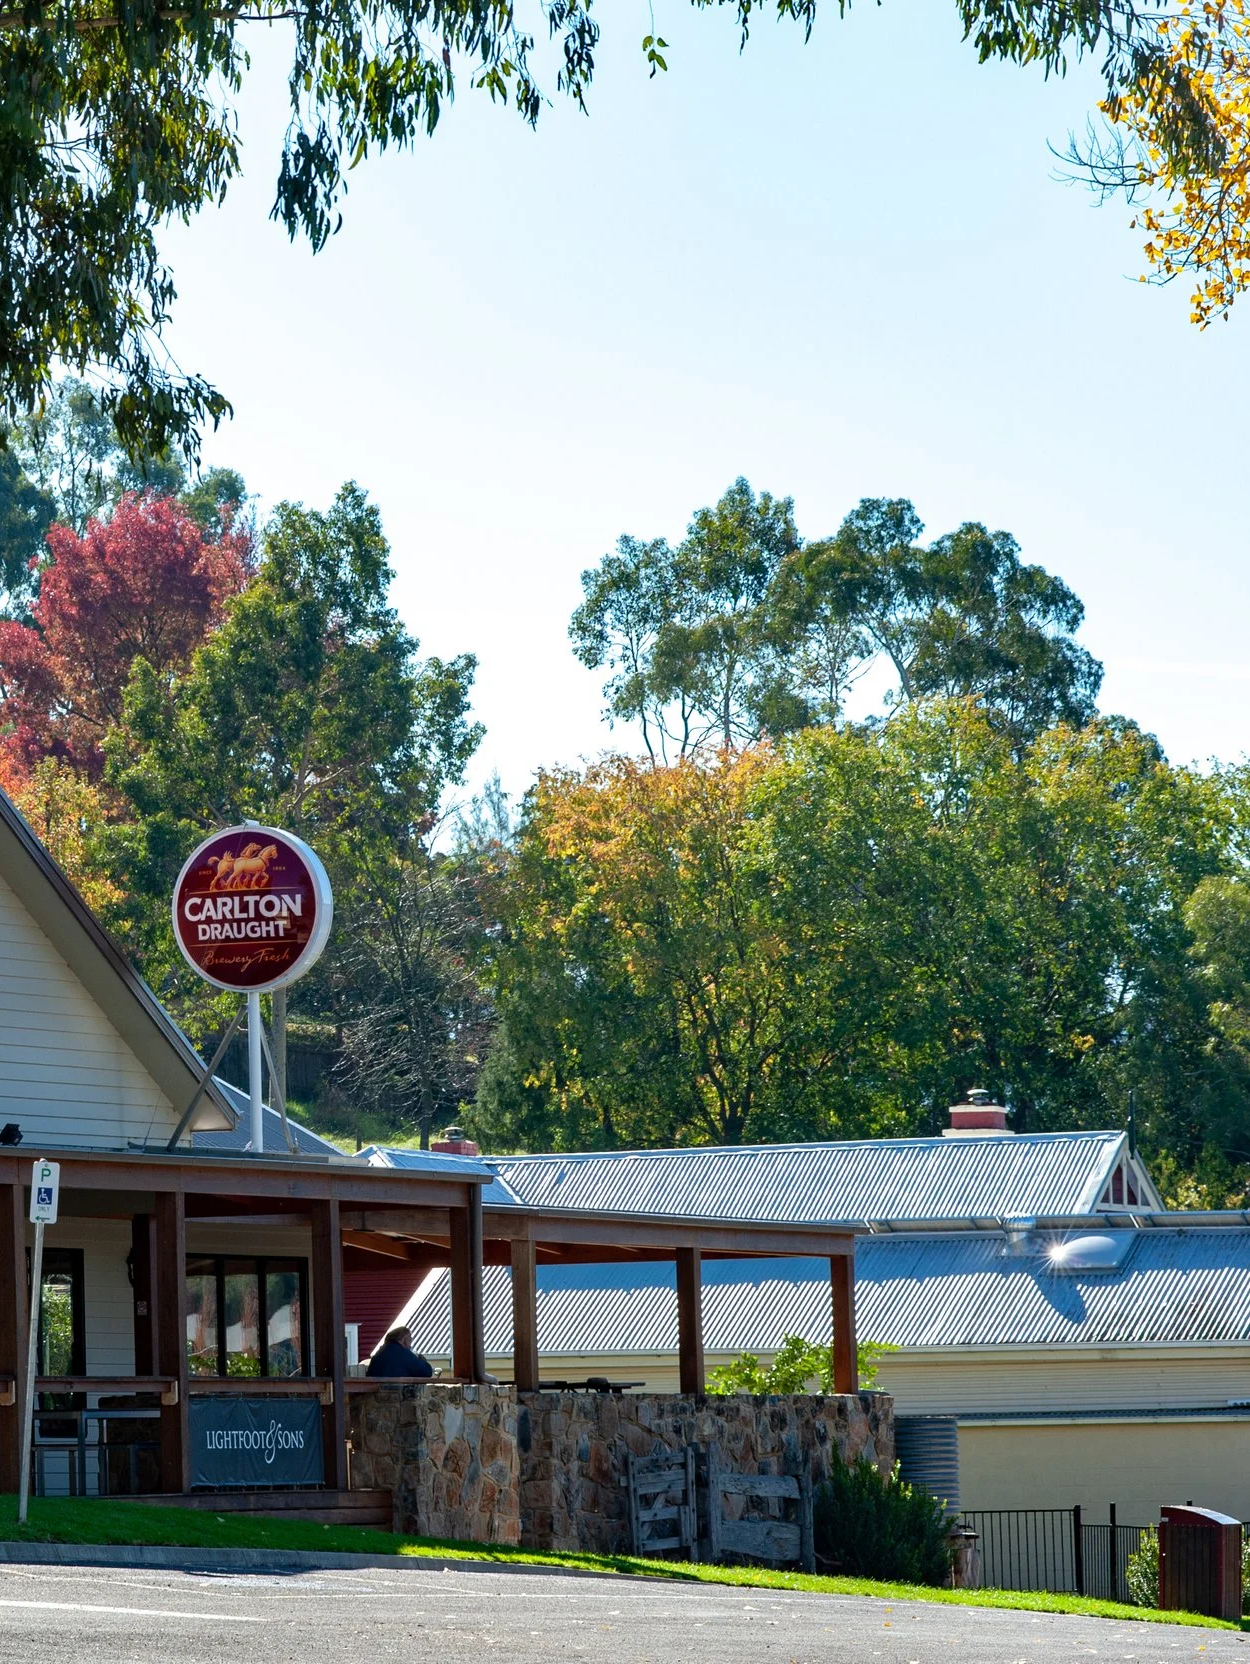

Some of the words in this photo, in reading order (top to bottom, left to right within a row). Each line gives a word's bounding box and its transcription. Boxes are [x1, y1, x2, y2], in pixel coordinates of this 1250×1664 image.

[184, 894, 302, 922] CARLTON
[197, 920, 287, 941] DRAUGHT
[202, 950, 251, 972] Brewery
[251, 948, 289, 963] Fresh
[41, 1168, 52, 1182] P
